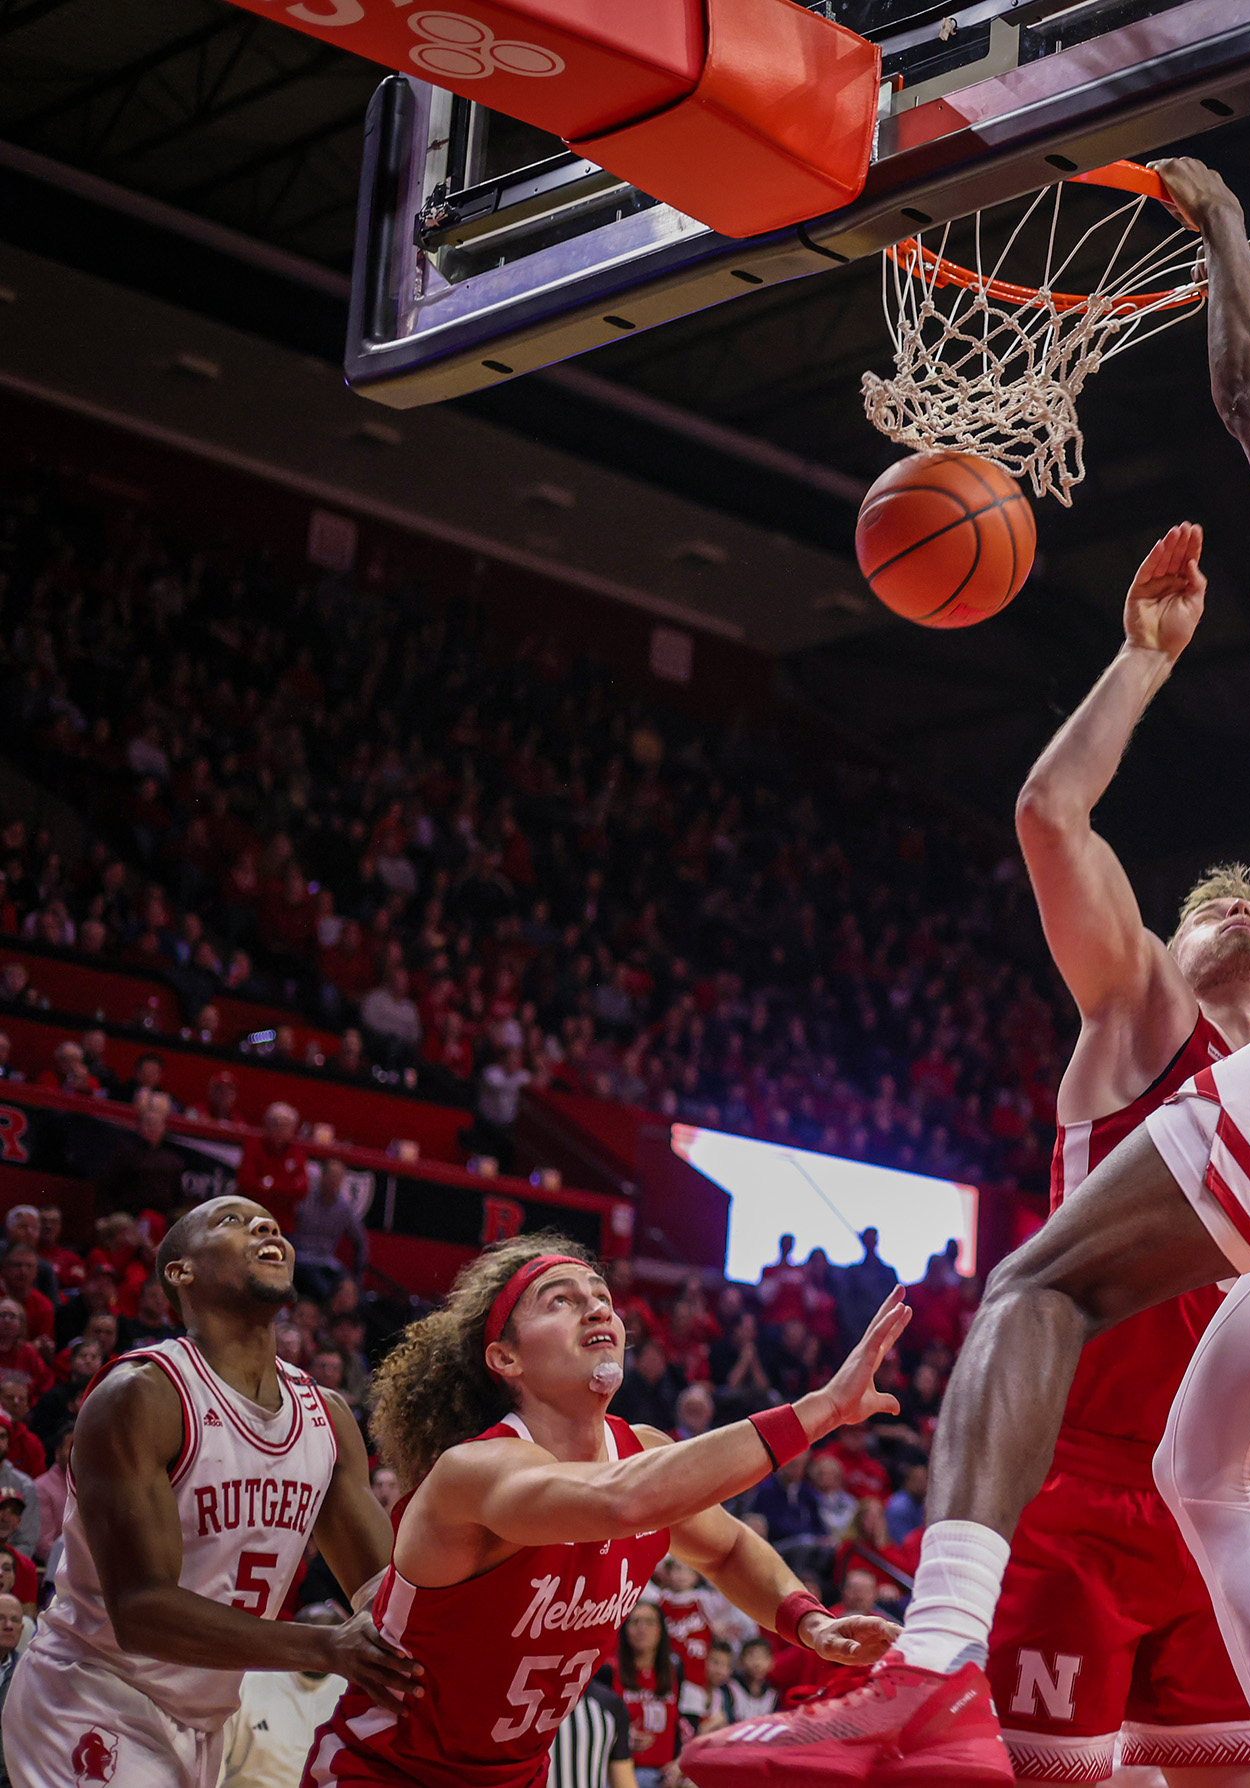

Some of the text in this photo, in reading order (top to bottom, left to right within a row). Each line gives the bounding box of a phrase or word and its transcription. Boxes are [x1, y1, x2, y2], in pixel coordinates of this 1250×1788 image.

[233, 1551, 279, 1618] 5
[511, 1558, 641, 1640] Nebraska
[491, 1648, 600, 1743] 53
[1009, 1648, 1083, 1720] N
